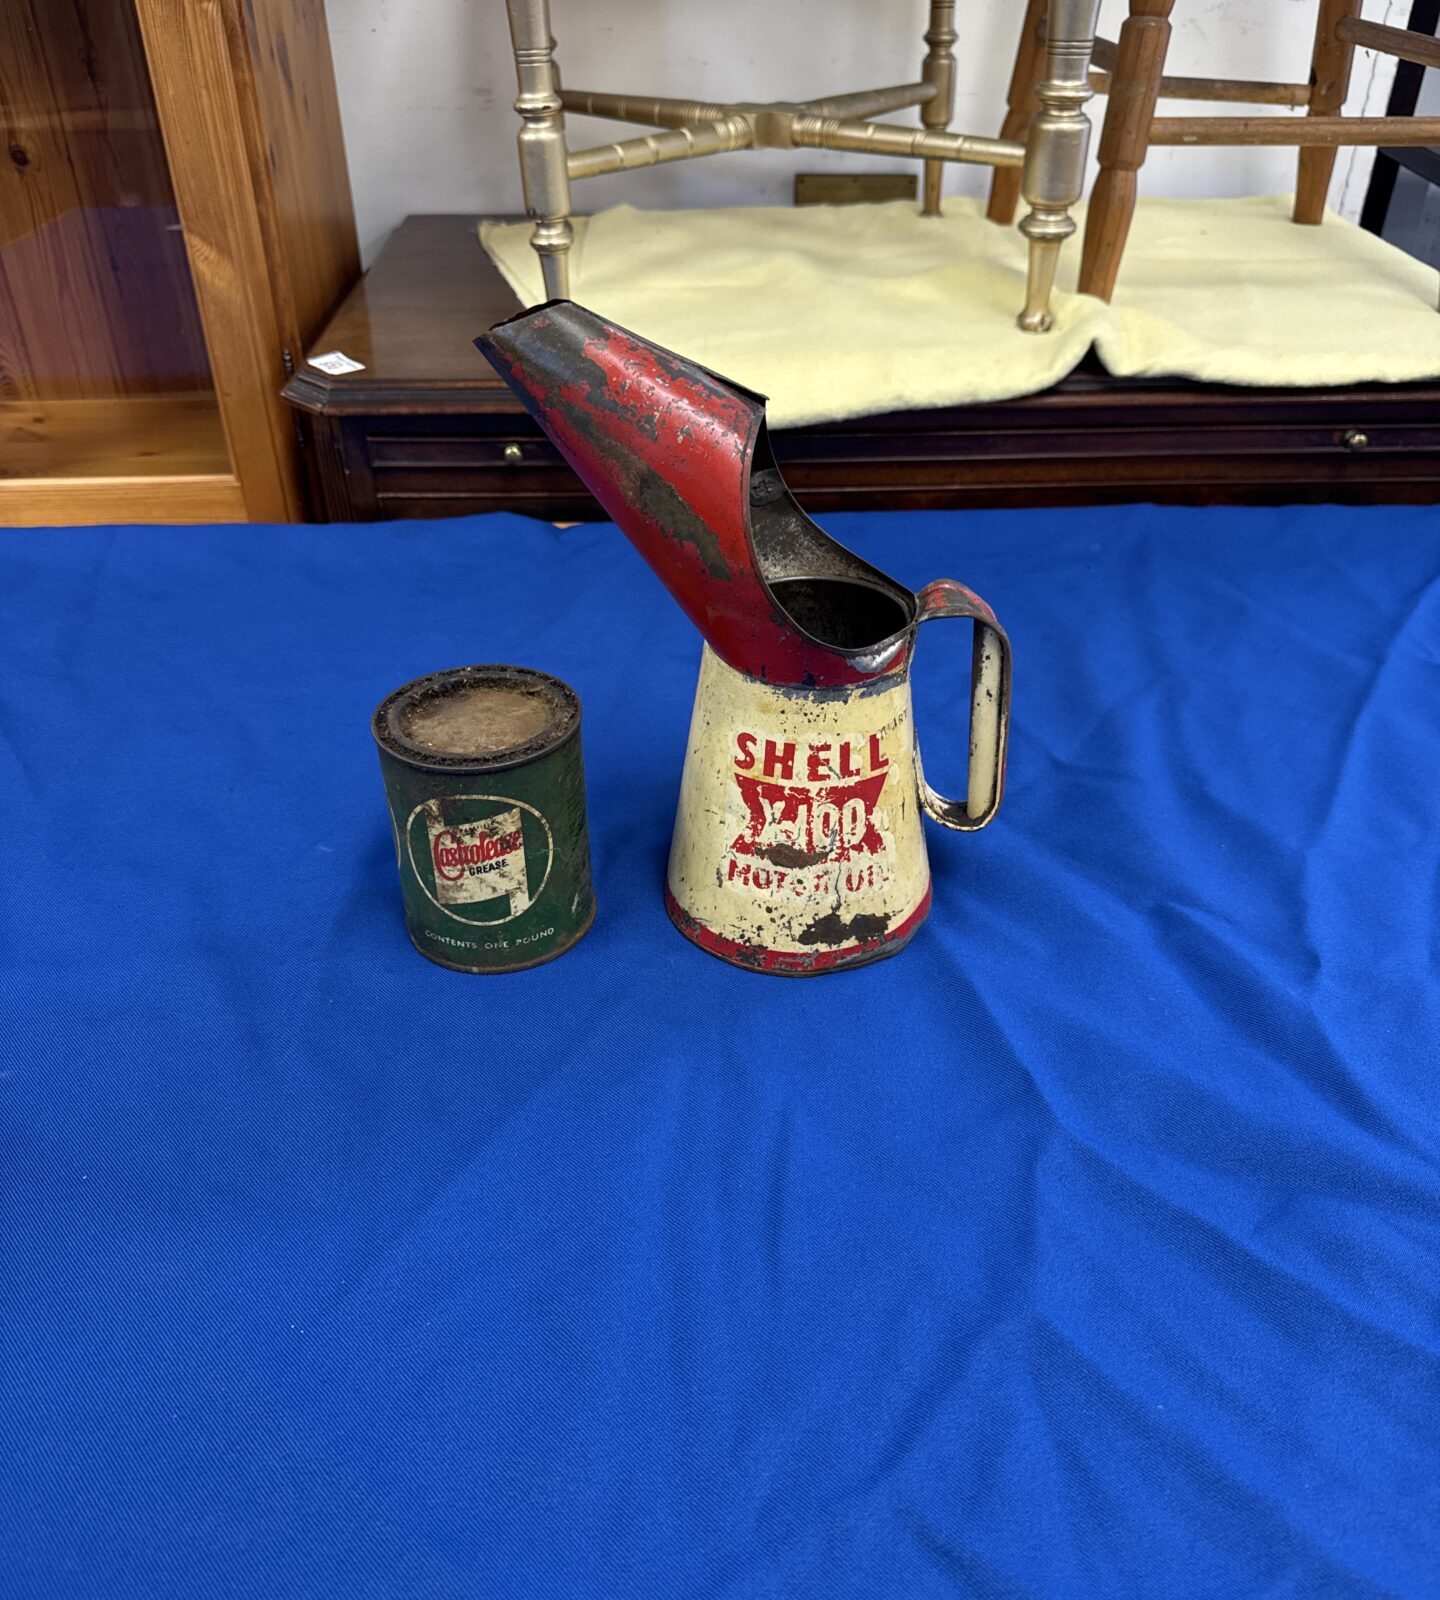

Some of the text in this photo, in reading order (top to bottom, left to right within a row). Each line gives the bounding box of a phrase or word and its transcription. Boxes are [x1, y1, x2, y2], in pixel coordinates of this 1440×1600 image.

[734, 732, 889, 782] SHELL
[433, 829, 522, 881] Castrolease
[469, 858, 509, 876] GREASE
[424, 927, 555, 949] CONTENTS ONE POUND
